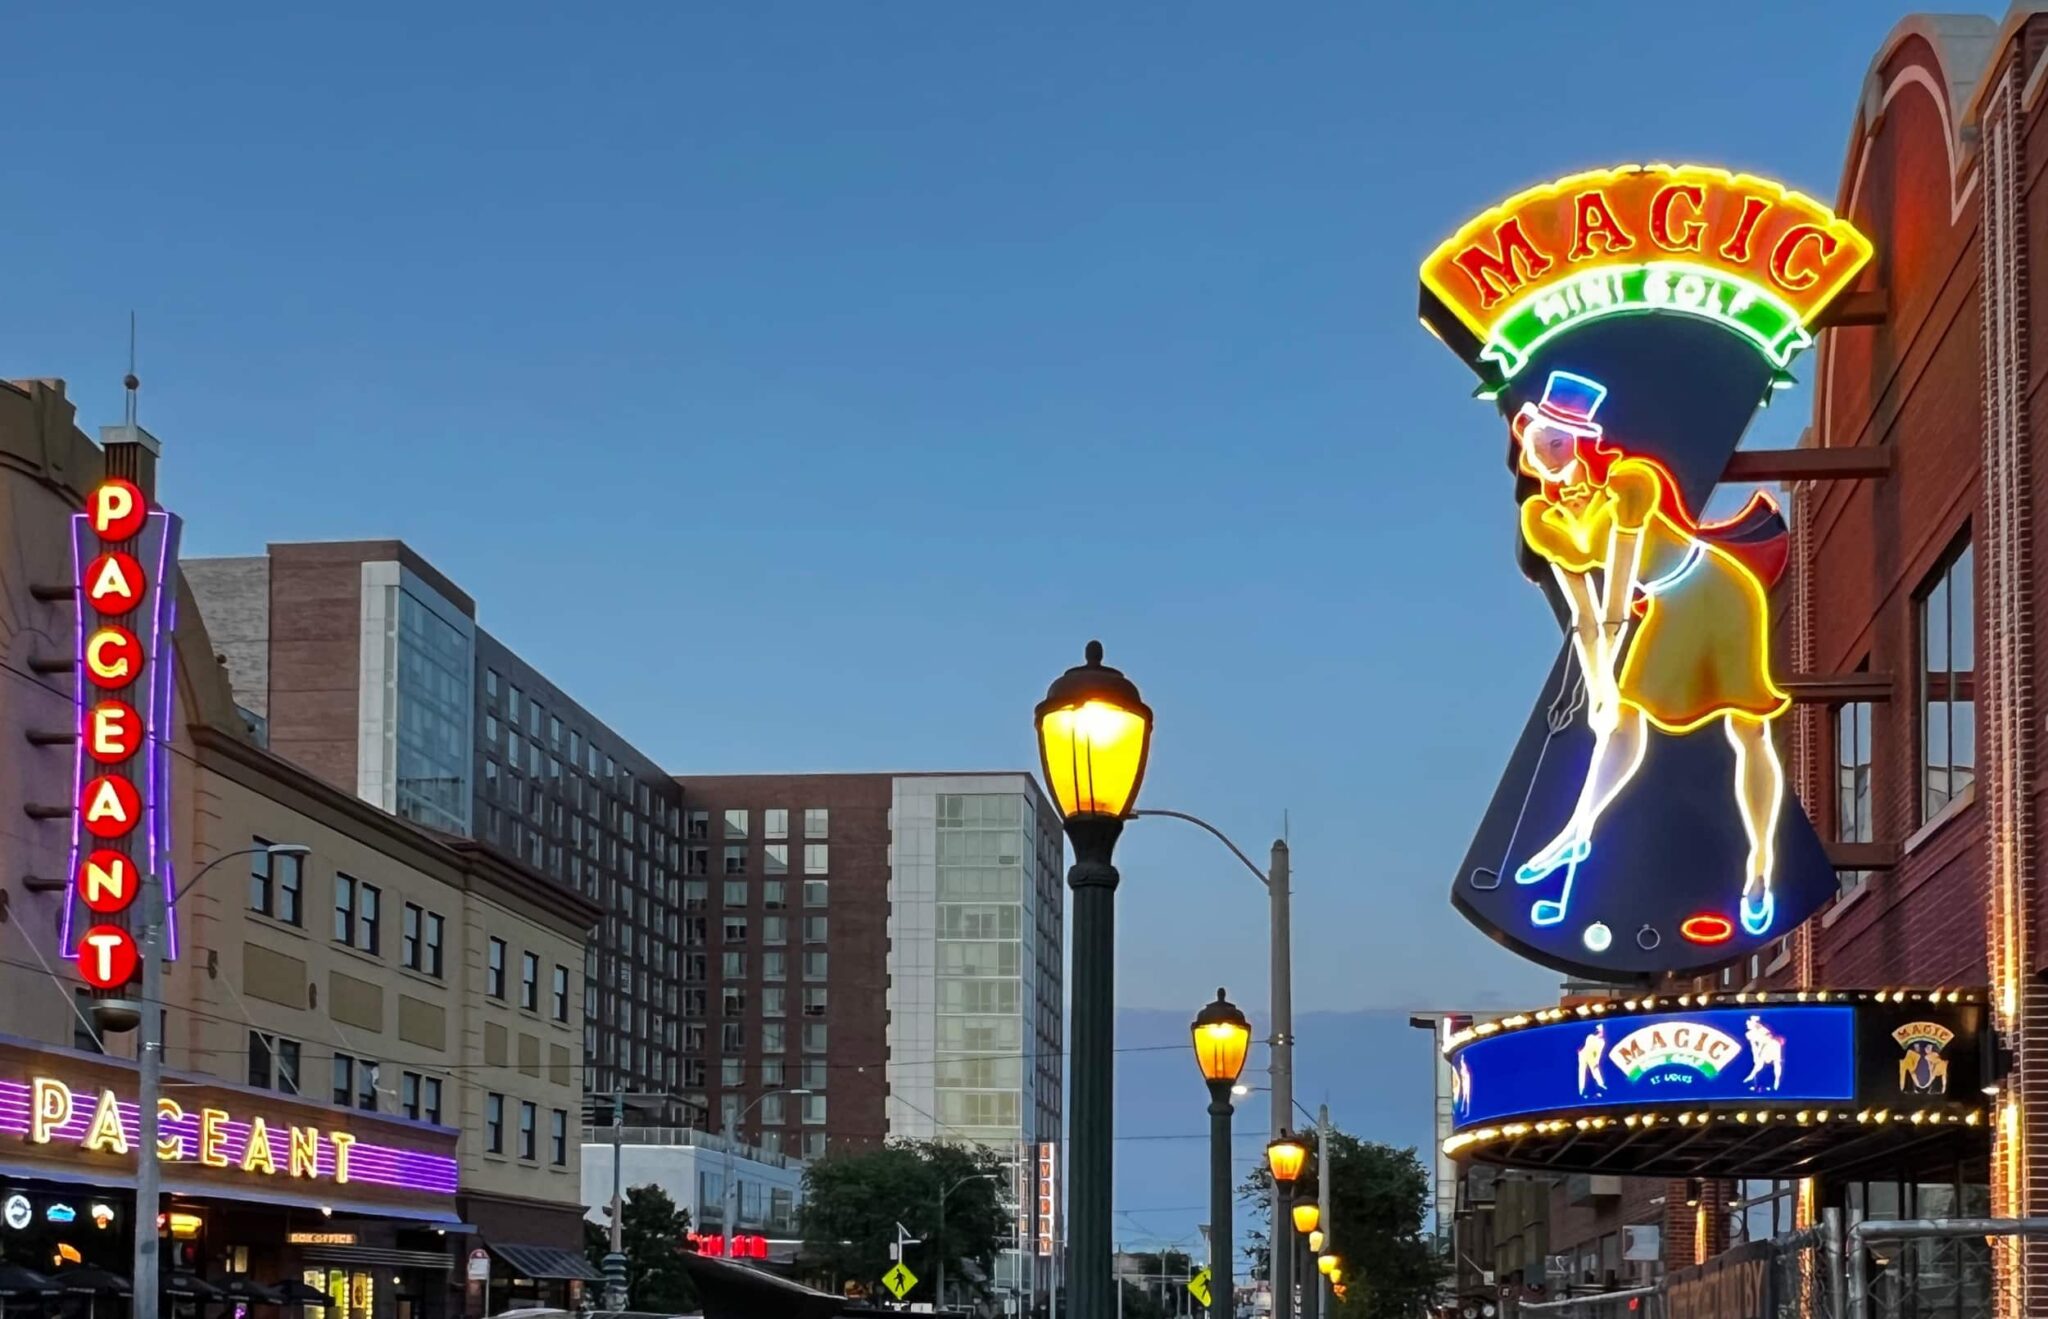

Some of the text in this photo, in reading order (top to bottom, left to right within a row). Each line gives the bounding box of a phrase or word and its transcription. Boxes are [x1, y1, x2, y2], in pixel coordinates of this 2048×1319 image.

[1453, 184, 1838, 310] MAGIC
[1534, 269, 1757, 325] MINI GOLF
[86, 484, 132, 981] PAGEANT
[1618, 1028, 1730, 1065] MAGIC
[1897, 1024, 1949, 1040] MAGIC
[31, 1076, 356, 1184] PAGEANT
